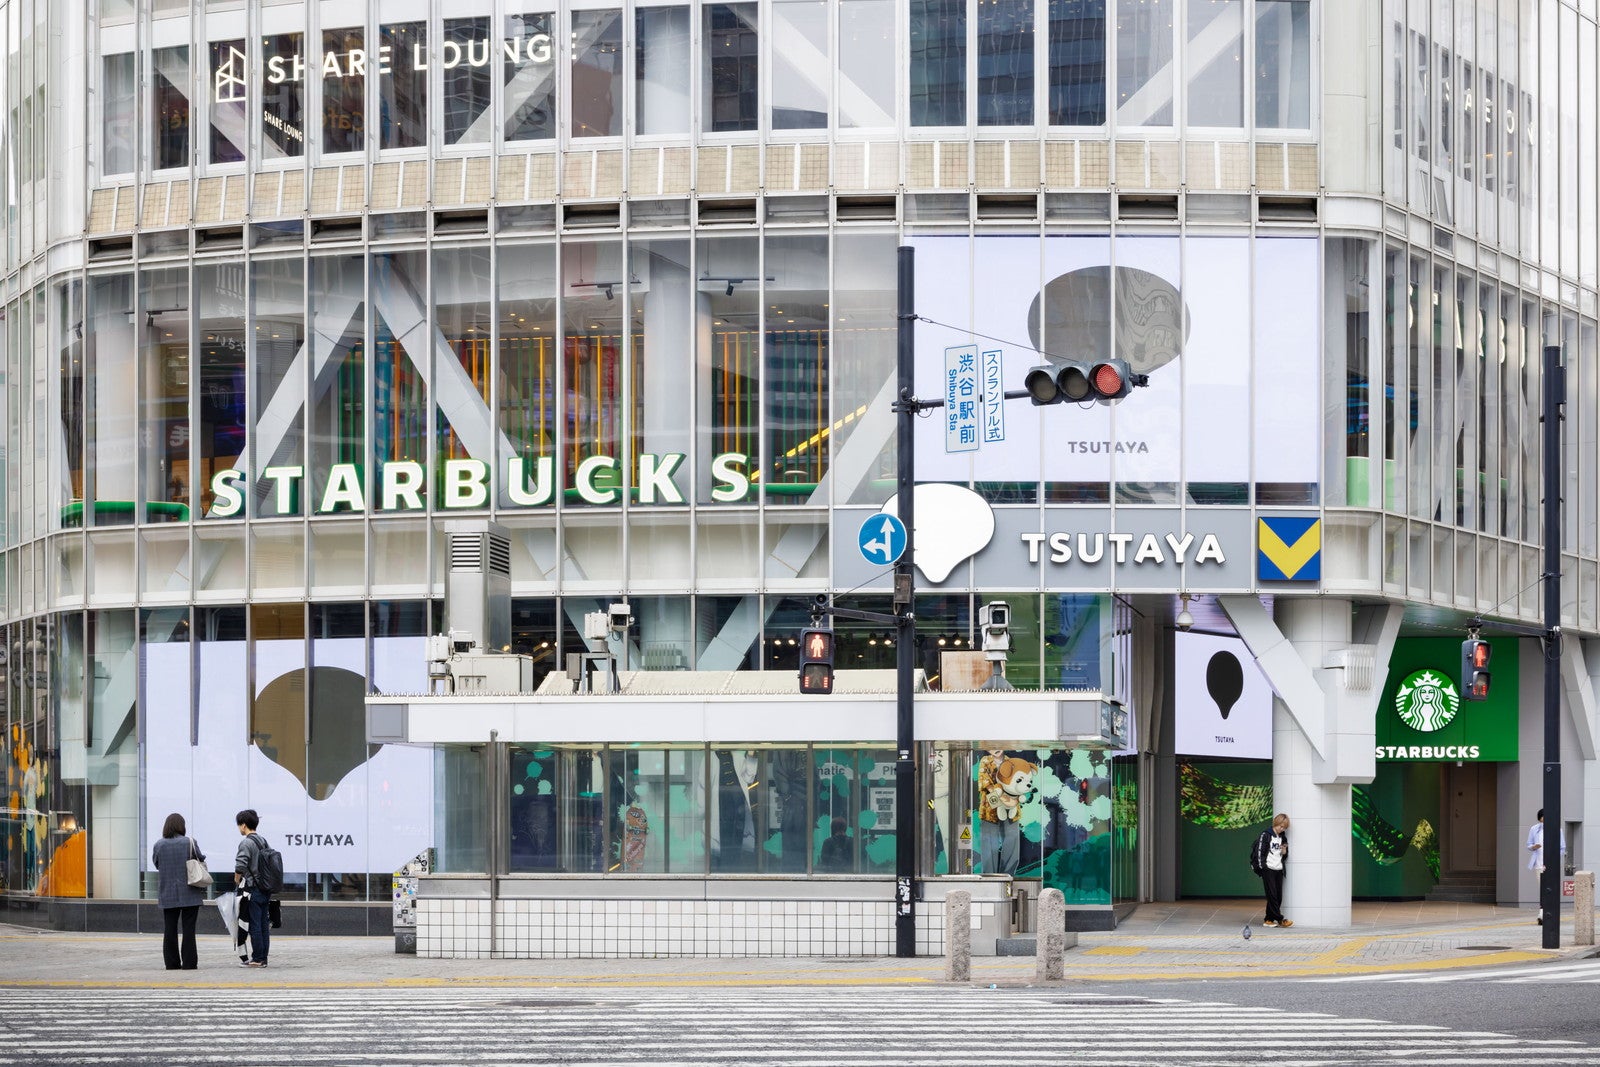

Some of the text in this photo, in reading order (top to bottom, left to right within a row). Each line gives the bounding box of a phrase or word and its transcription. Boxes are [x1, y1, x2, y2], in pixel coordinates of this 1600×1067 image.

[268, 46, 391, 84] SHARE
[264, 111, 282, 130] SHARE
[948, 368, 958, 434] Shibuya Sta.
[959, 353, 975, 444] 渋谷駅前
[1068, 441, 1149, 454] TSUTAYA
[211, 453, 752, 517] STARBUCKS
[1021, 532, 1226, 565] TSUTAYA
[1215, 735, 1235, 743] TSUTAYA
[1376, 746, 1480, 759] STARBUCKS
[285, 834, 354, 846] TSUTAYA
